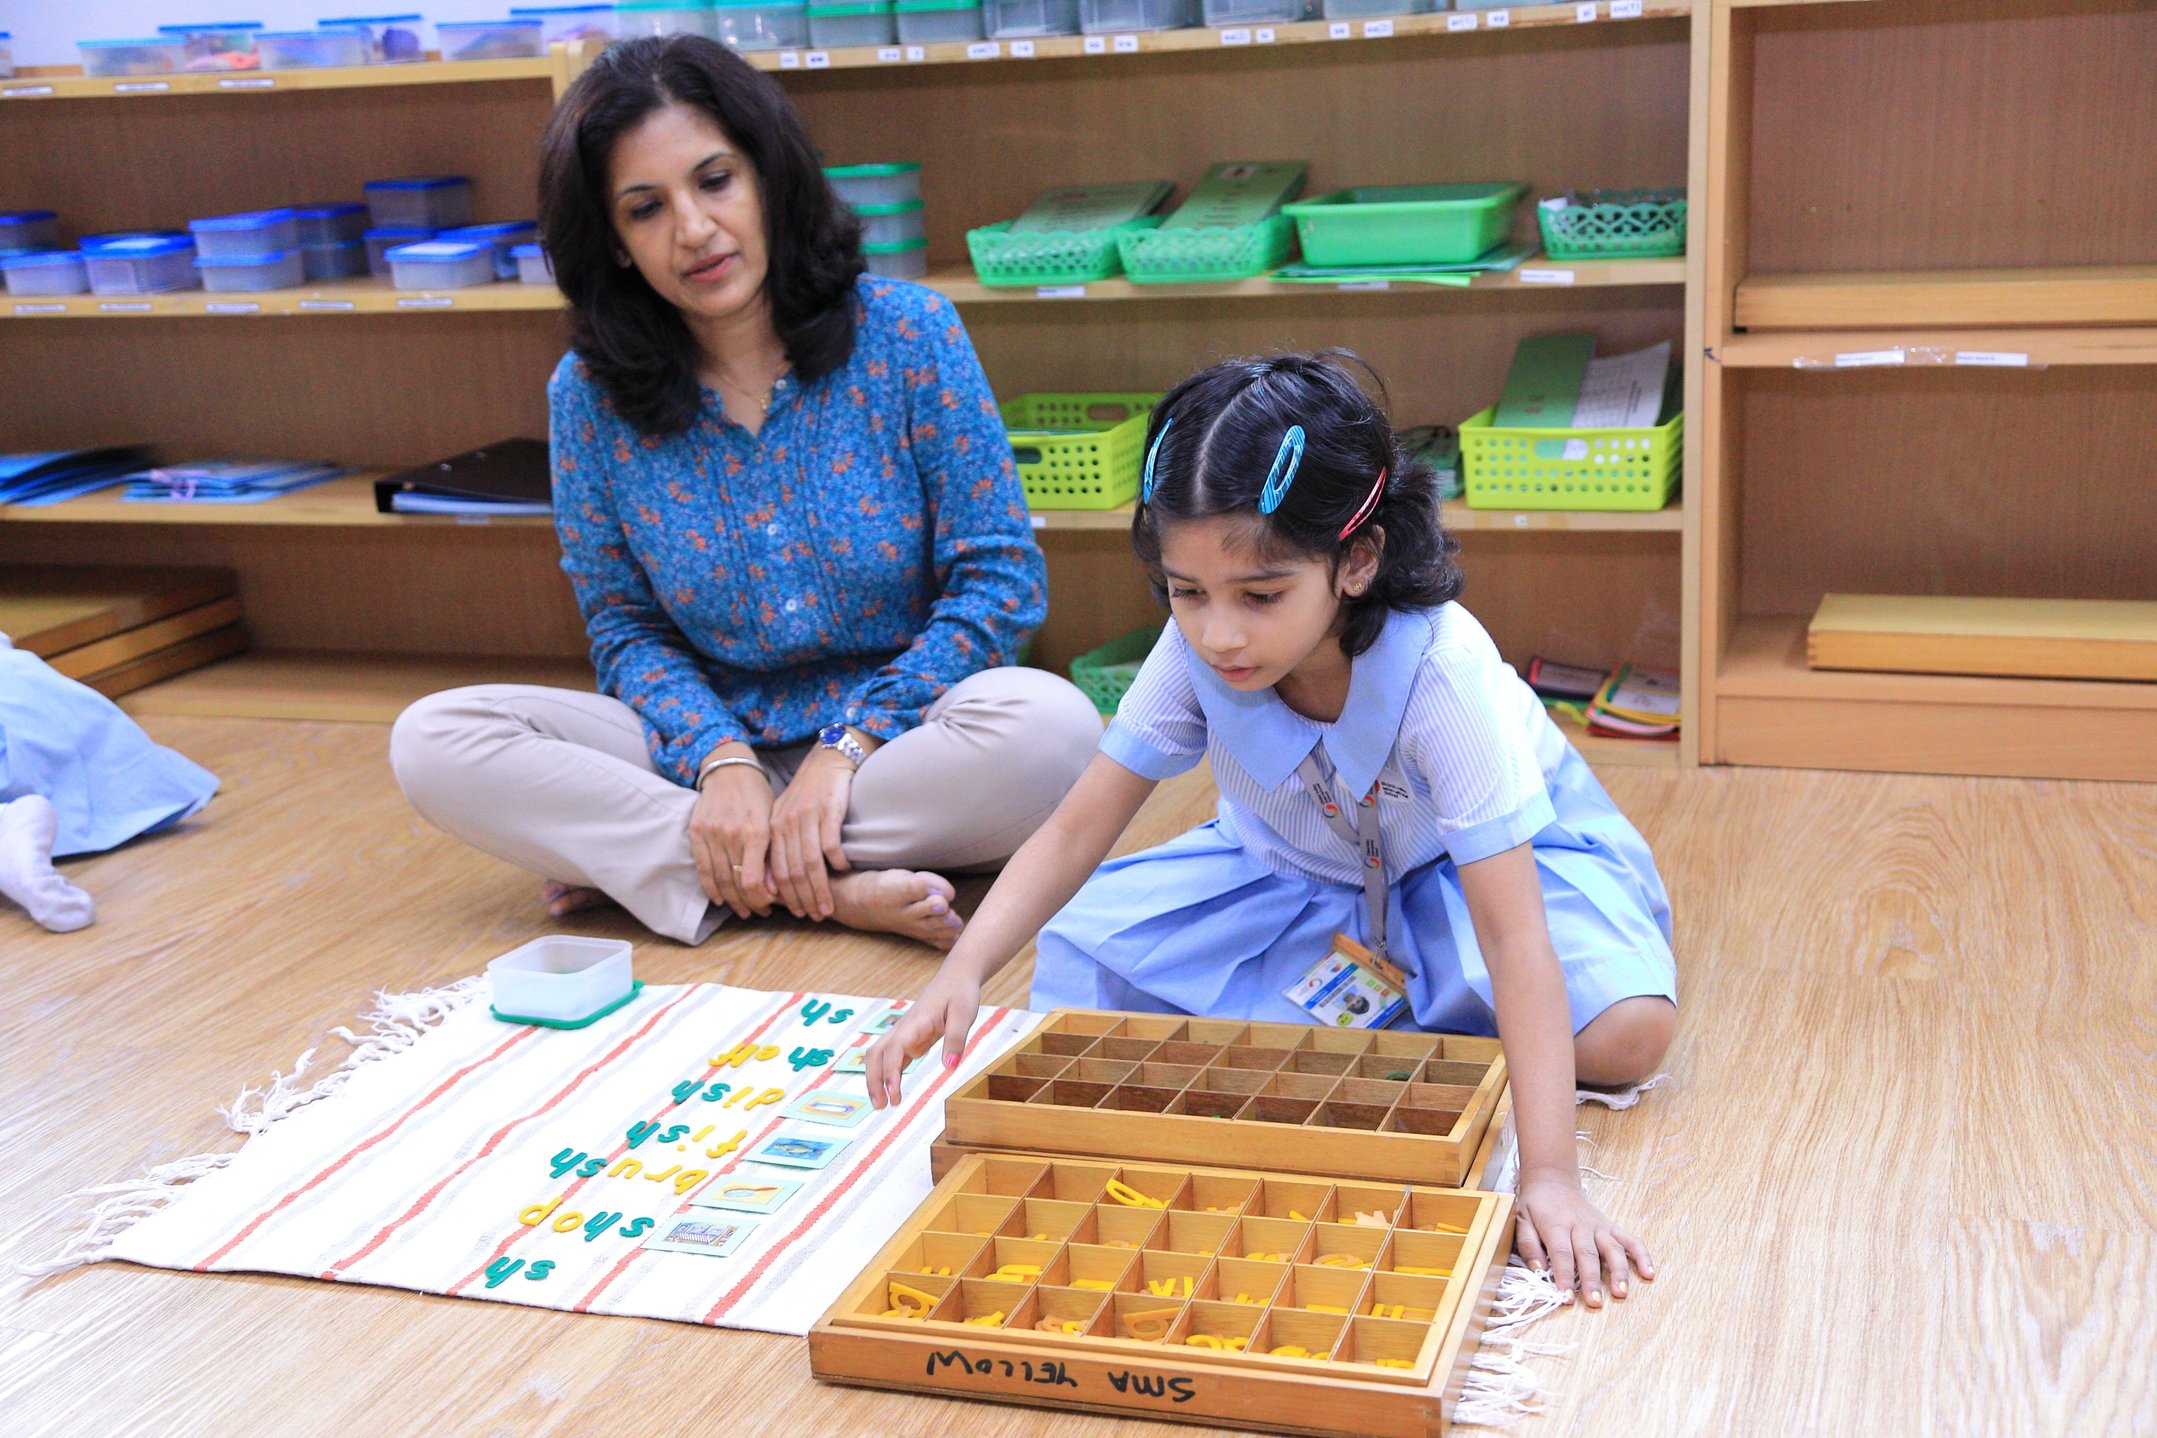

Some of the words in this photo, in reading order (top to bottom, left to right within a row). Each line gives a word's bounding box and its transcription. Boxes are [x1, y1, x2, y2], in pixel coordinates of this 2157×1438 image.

[801, 998, 854, 1027] sh
[671, 1080, 785, 1111] dish
[626, 1120, 748, 1160] fish
[549, 1147, 709, 1196] brush
[518, 1196, 655, 1243] shop
[484, 1255, 556, 1290] sh
[926, 1350, 1078, 1389] YELLOW
[1108, 1370, 1196, 1404] SMA
